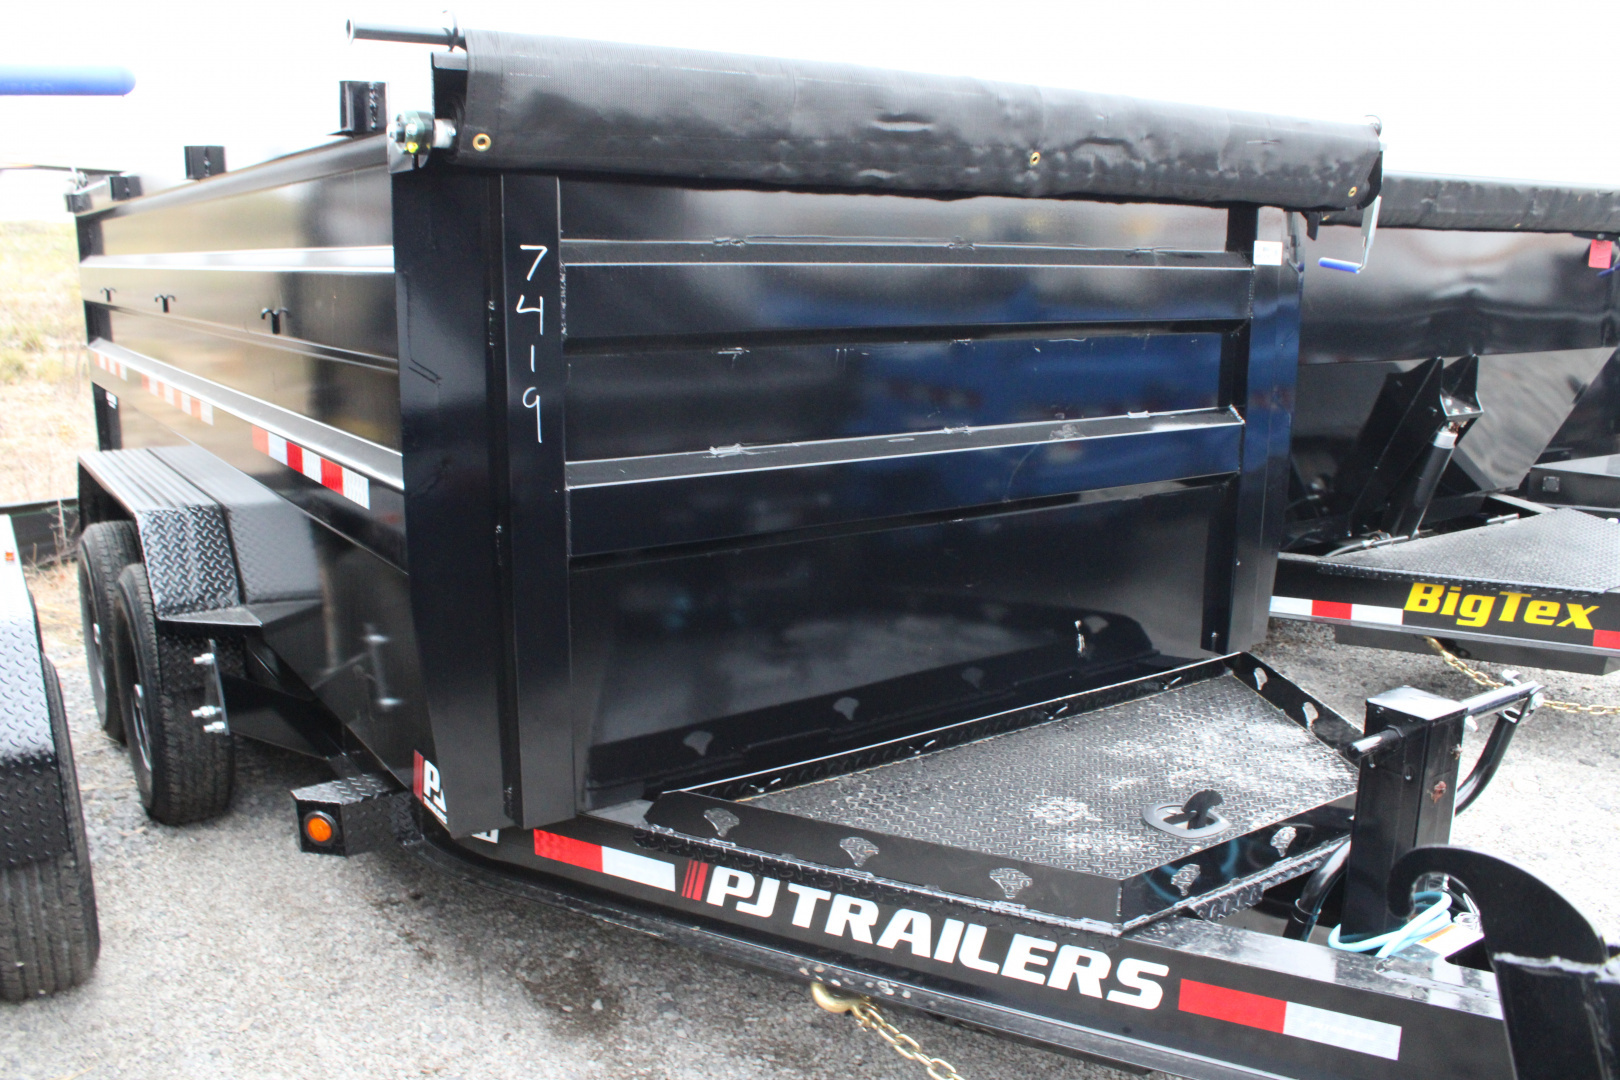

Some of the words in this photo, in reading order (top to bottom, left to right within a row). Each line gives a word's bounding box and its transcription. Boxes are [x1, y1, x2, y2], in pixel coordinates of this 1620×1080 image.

[516, 244, 548, 443] 7419
[706, 865, 781, 918] PJ
[786, 883, 1170, 1010] TRAILERS
